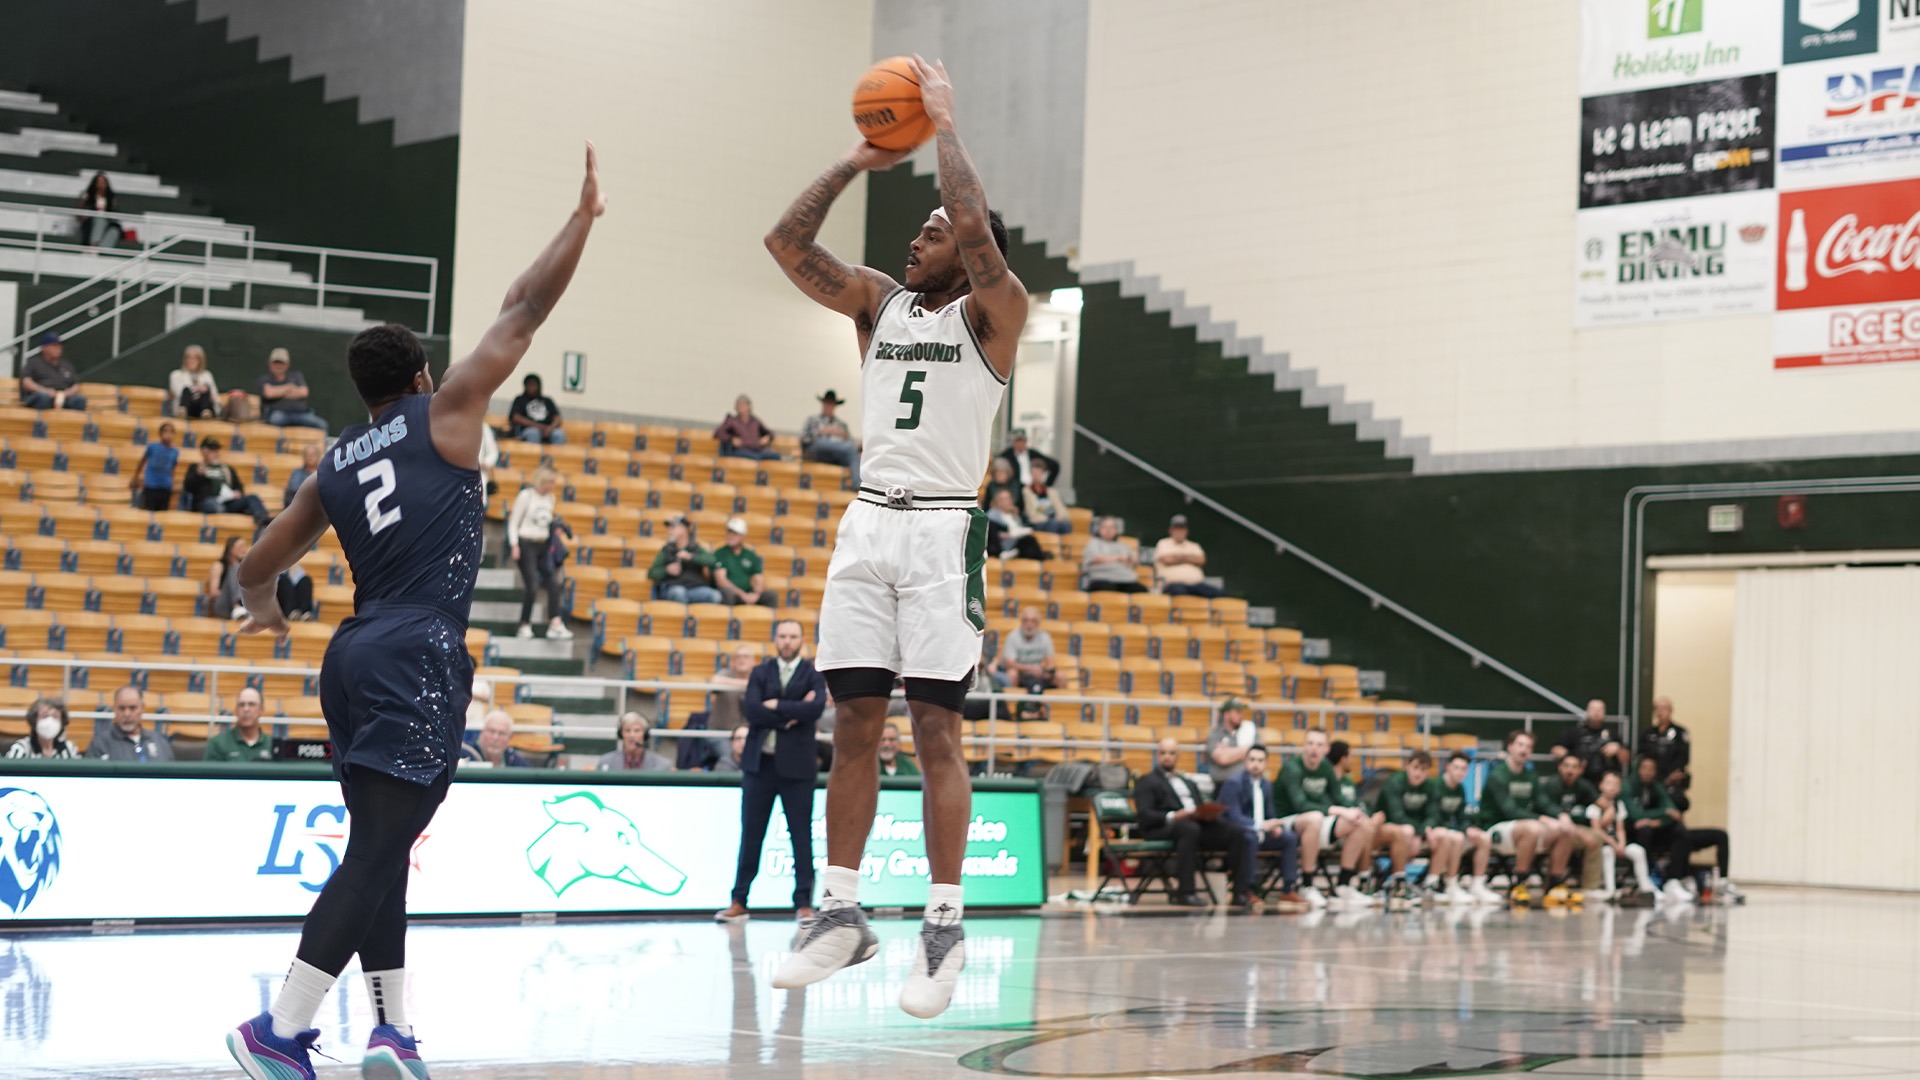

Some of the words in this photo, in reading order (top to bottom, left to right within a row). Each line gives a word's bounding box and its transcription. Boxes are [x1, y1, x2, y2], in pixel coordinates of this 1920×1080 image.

[1613, 46, 1700, 79] Holiday
[1704, 40, 1741, 66] Inn
[1619, 222, 1726, 258] ENMU
[1617, 252, 1724, 284] DINING
[569, 353, 582, 388] J
[875, 341, 964, 363] GREYHOUNDS
[895, 371, 927, 430] 5
[333, 414, 408, 472] LIONS
[357, 457, 402, 537] 2
